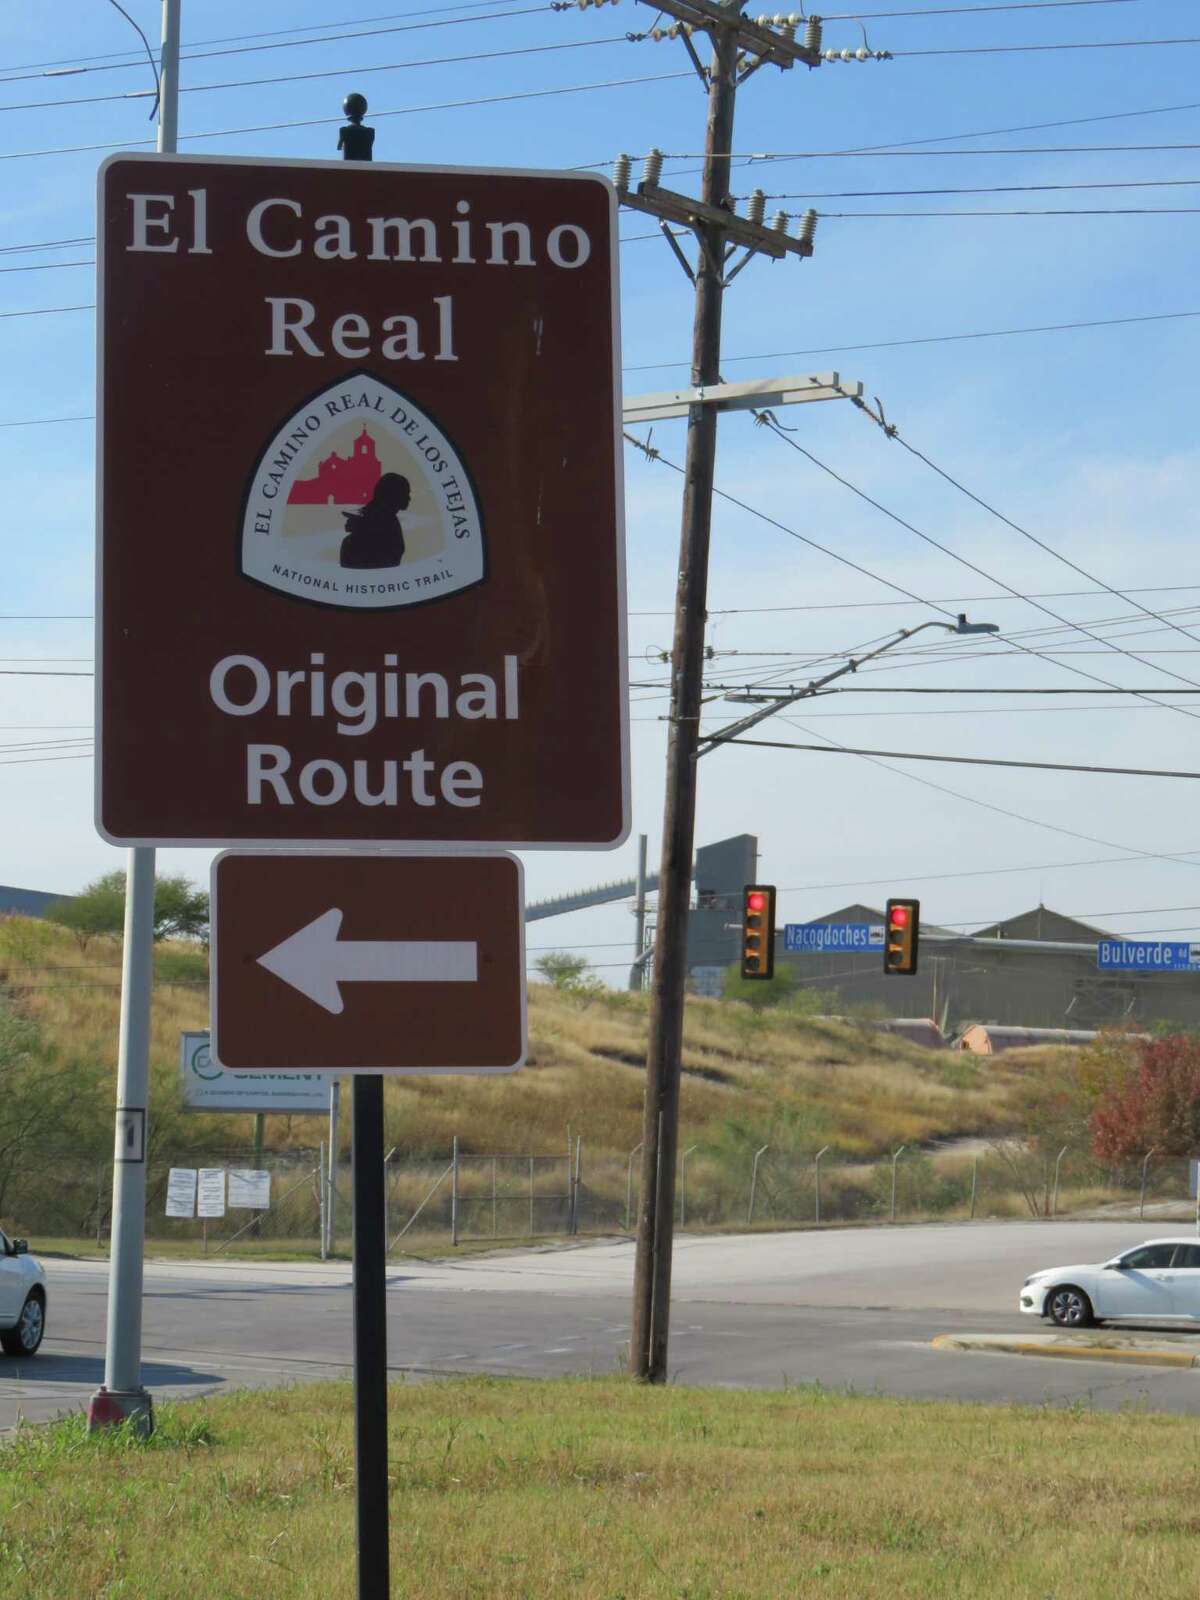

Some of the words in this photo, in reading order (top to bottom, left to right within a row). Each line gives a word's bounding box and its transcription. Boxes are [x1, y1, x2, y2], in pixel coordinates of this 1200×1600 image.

[125, 188, 213, 255] El
[245, 198, 592, 269] Camino
[264, 295, 459, 362] Real
[324, 392, 385, 417] REAL
[390, 407, 419, 435] DE
[262, 415, 320, 498] CAMINO
[416, 435, 448, 473] LOS
[255, 508, 272, 535] EL
[441, 475, 470, 539] TEJAS
[272, 564, 339, 591] NATIONAL
[346, 581, 410, 594] HISTORIC
[415, 569, 453, 587] TRAIL
[209, 652, 519, 736] Original
[247, 744, 483, 807] Route
[787, 924, 867, 950] Nacogdoches
[1102, 942, 1172, 964] Bulverde
